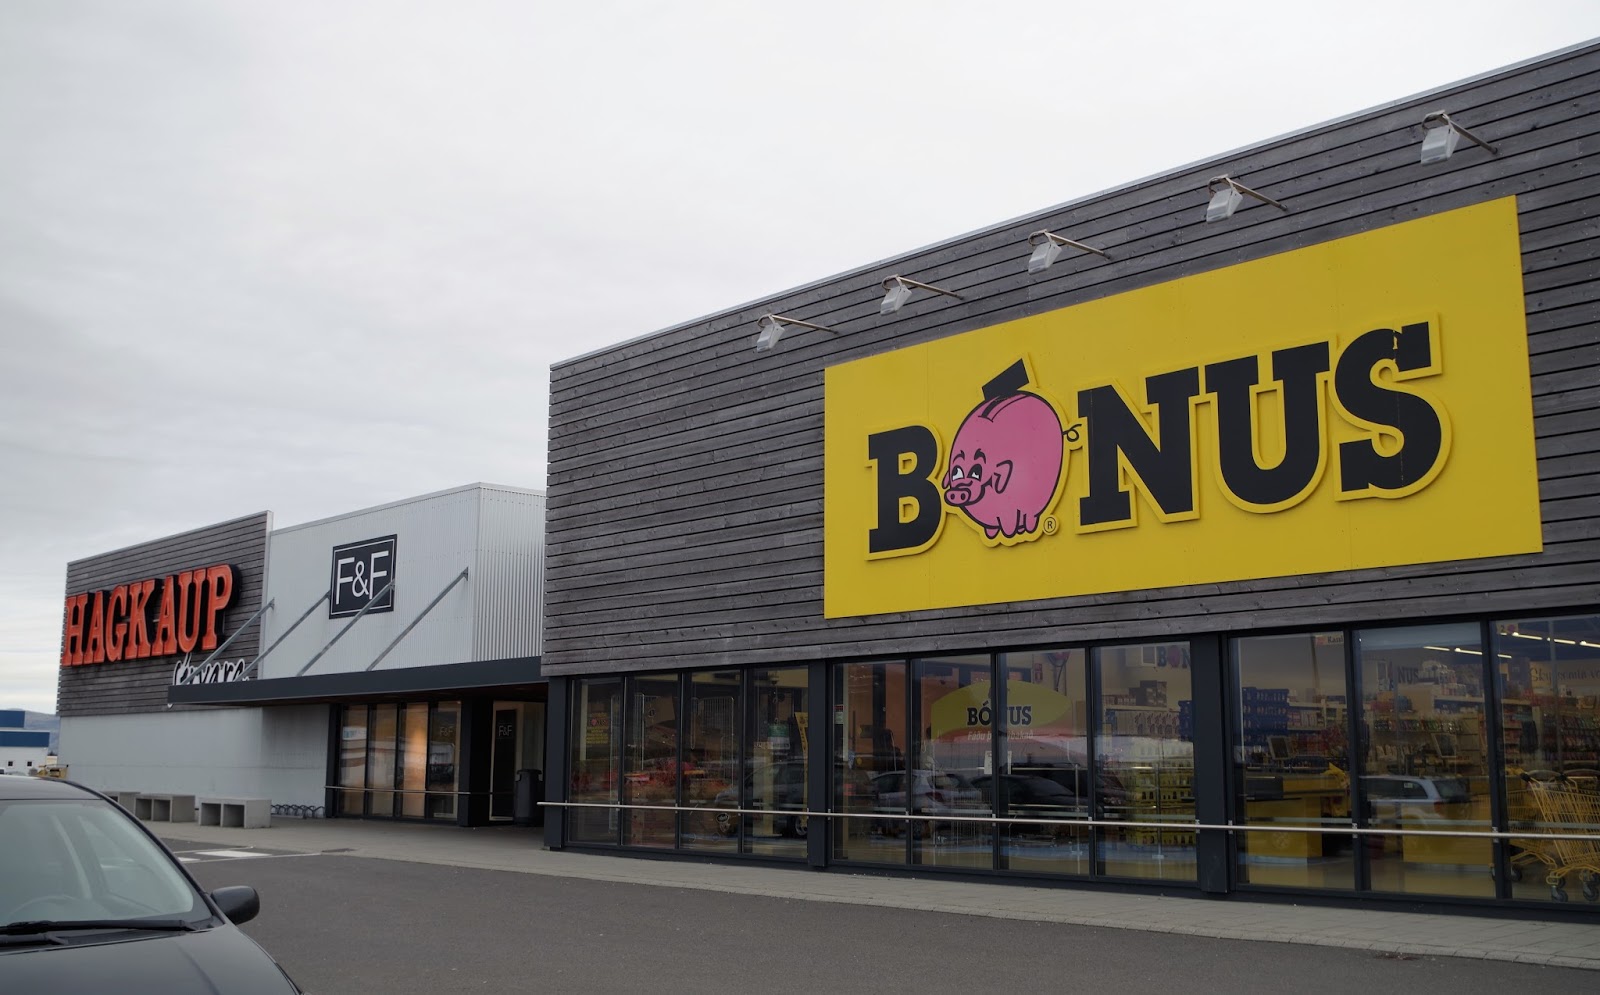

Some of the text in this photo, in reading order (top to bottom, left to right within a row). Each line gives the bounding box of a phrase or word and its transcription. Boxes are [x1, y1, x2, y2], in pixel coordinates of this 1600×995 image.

[335, 550, 390, 606] F&F
[62, 563, 238, 668] HAGKAUP
[498, 725, 513, 737] F&F
[966, 700, 1032, 726] BÓUS
